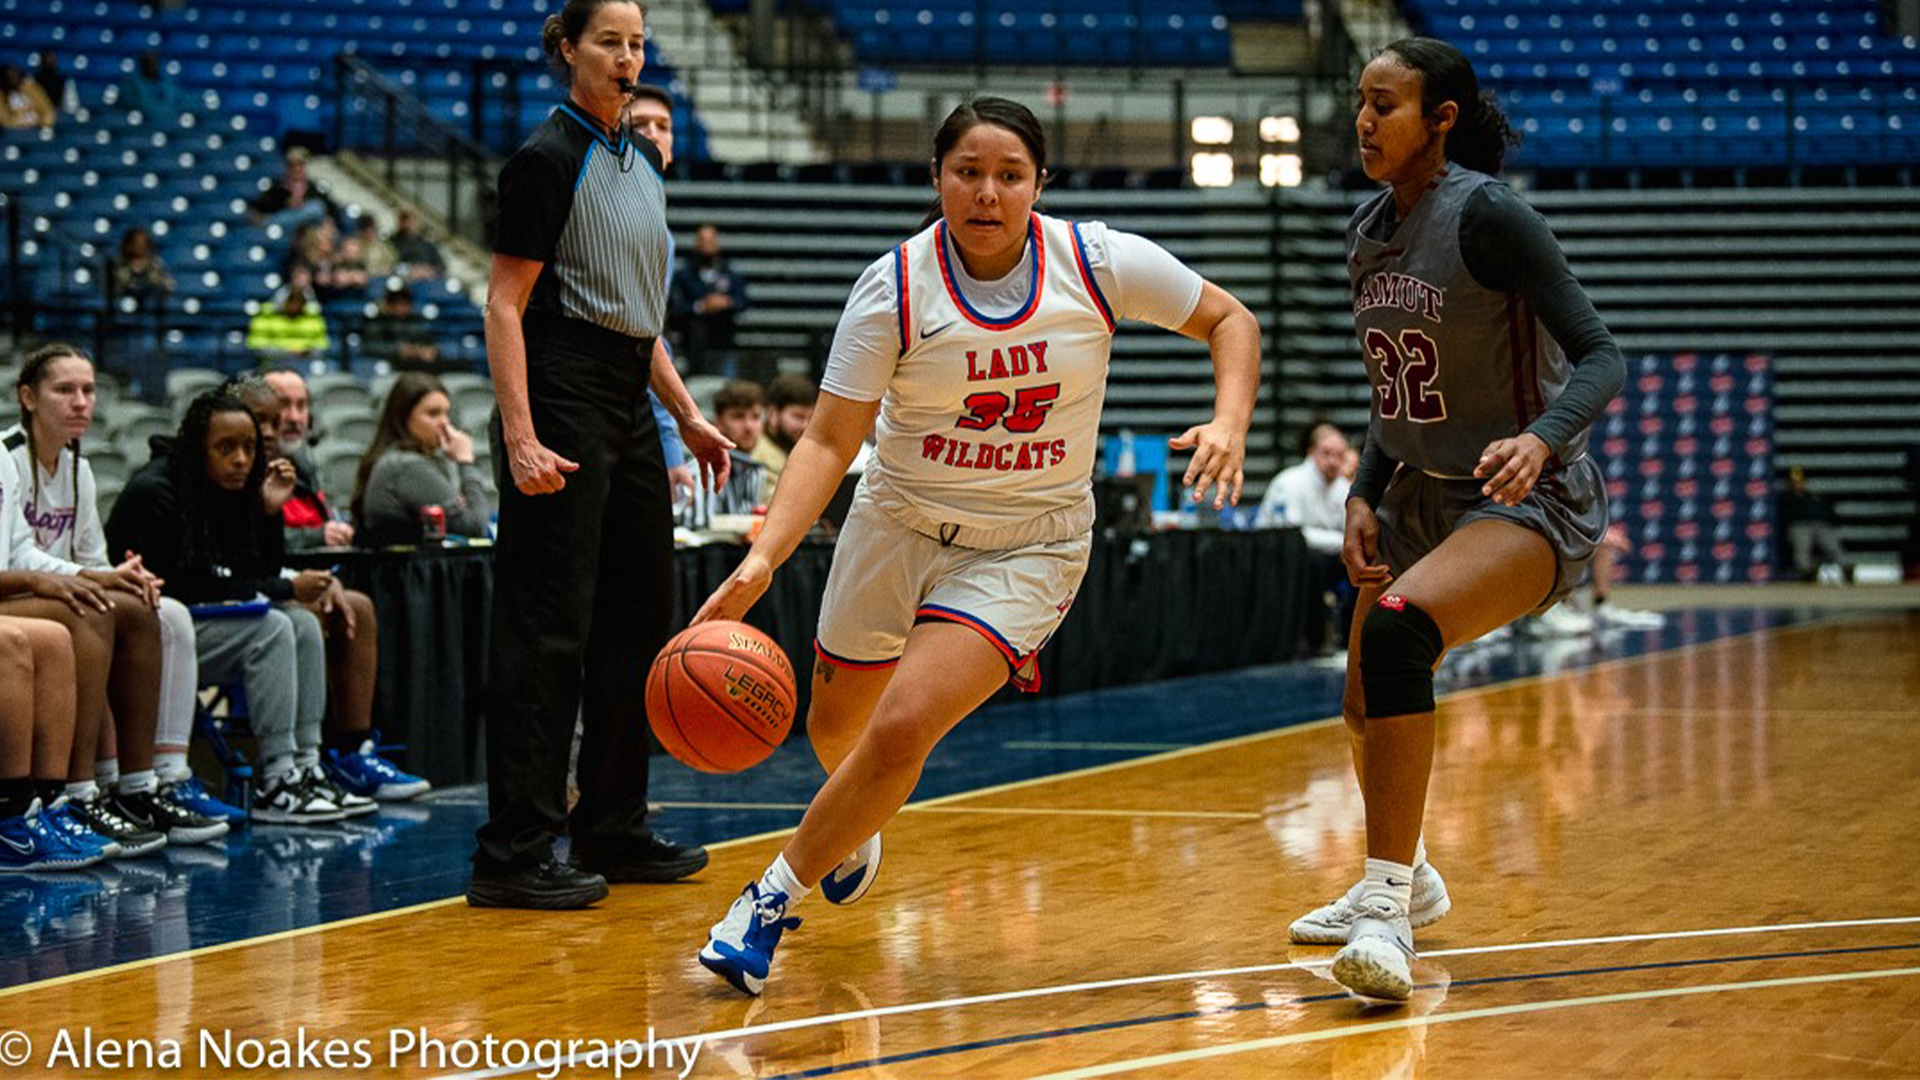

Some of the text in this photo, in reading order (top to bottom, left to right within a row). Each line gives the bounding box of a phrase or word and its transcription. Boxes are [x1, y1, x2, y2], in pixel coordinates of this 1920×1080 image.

[1355, 272, 1443, 323] AMUT
[965, 340, 1048, 381] LADY
[1364, 327, 1448, 423] 32
[955, 382, 1061, 433] 35
[921, 433, 1067, 472] WILDCATS
[724, 663, 790, 721] LEGACY
